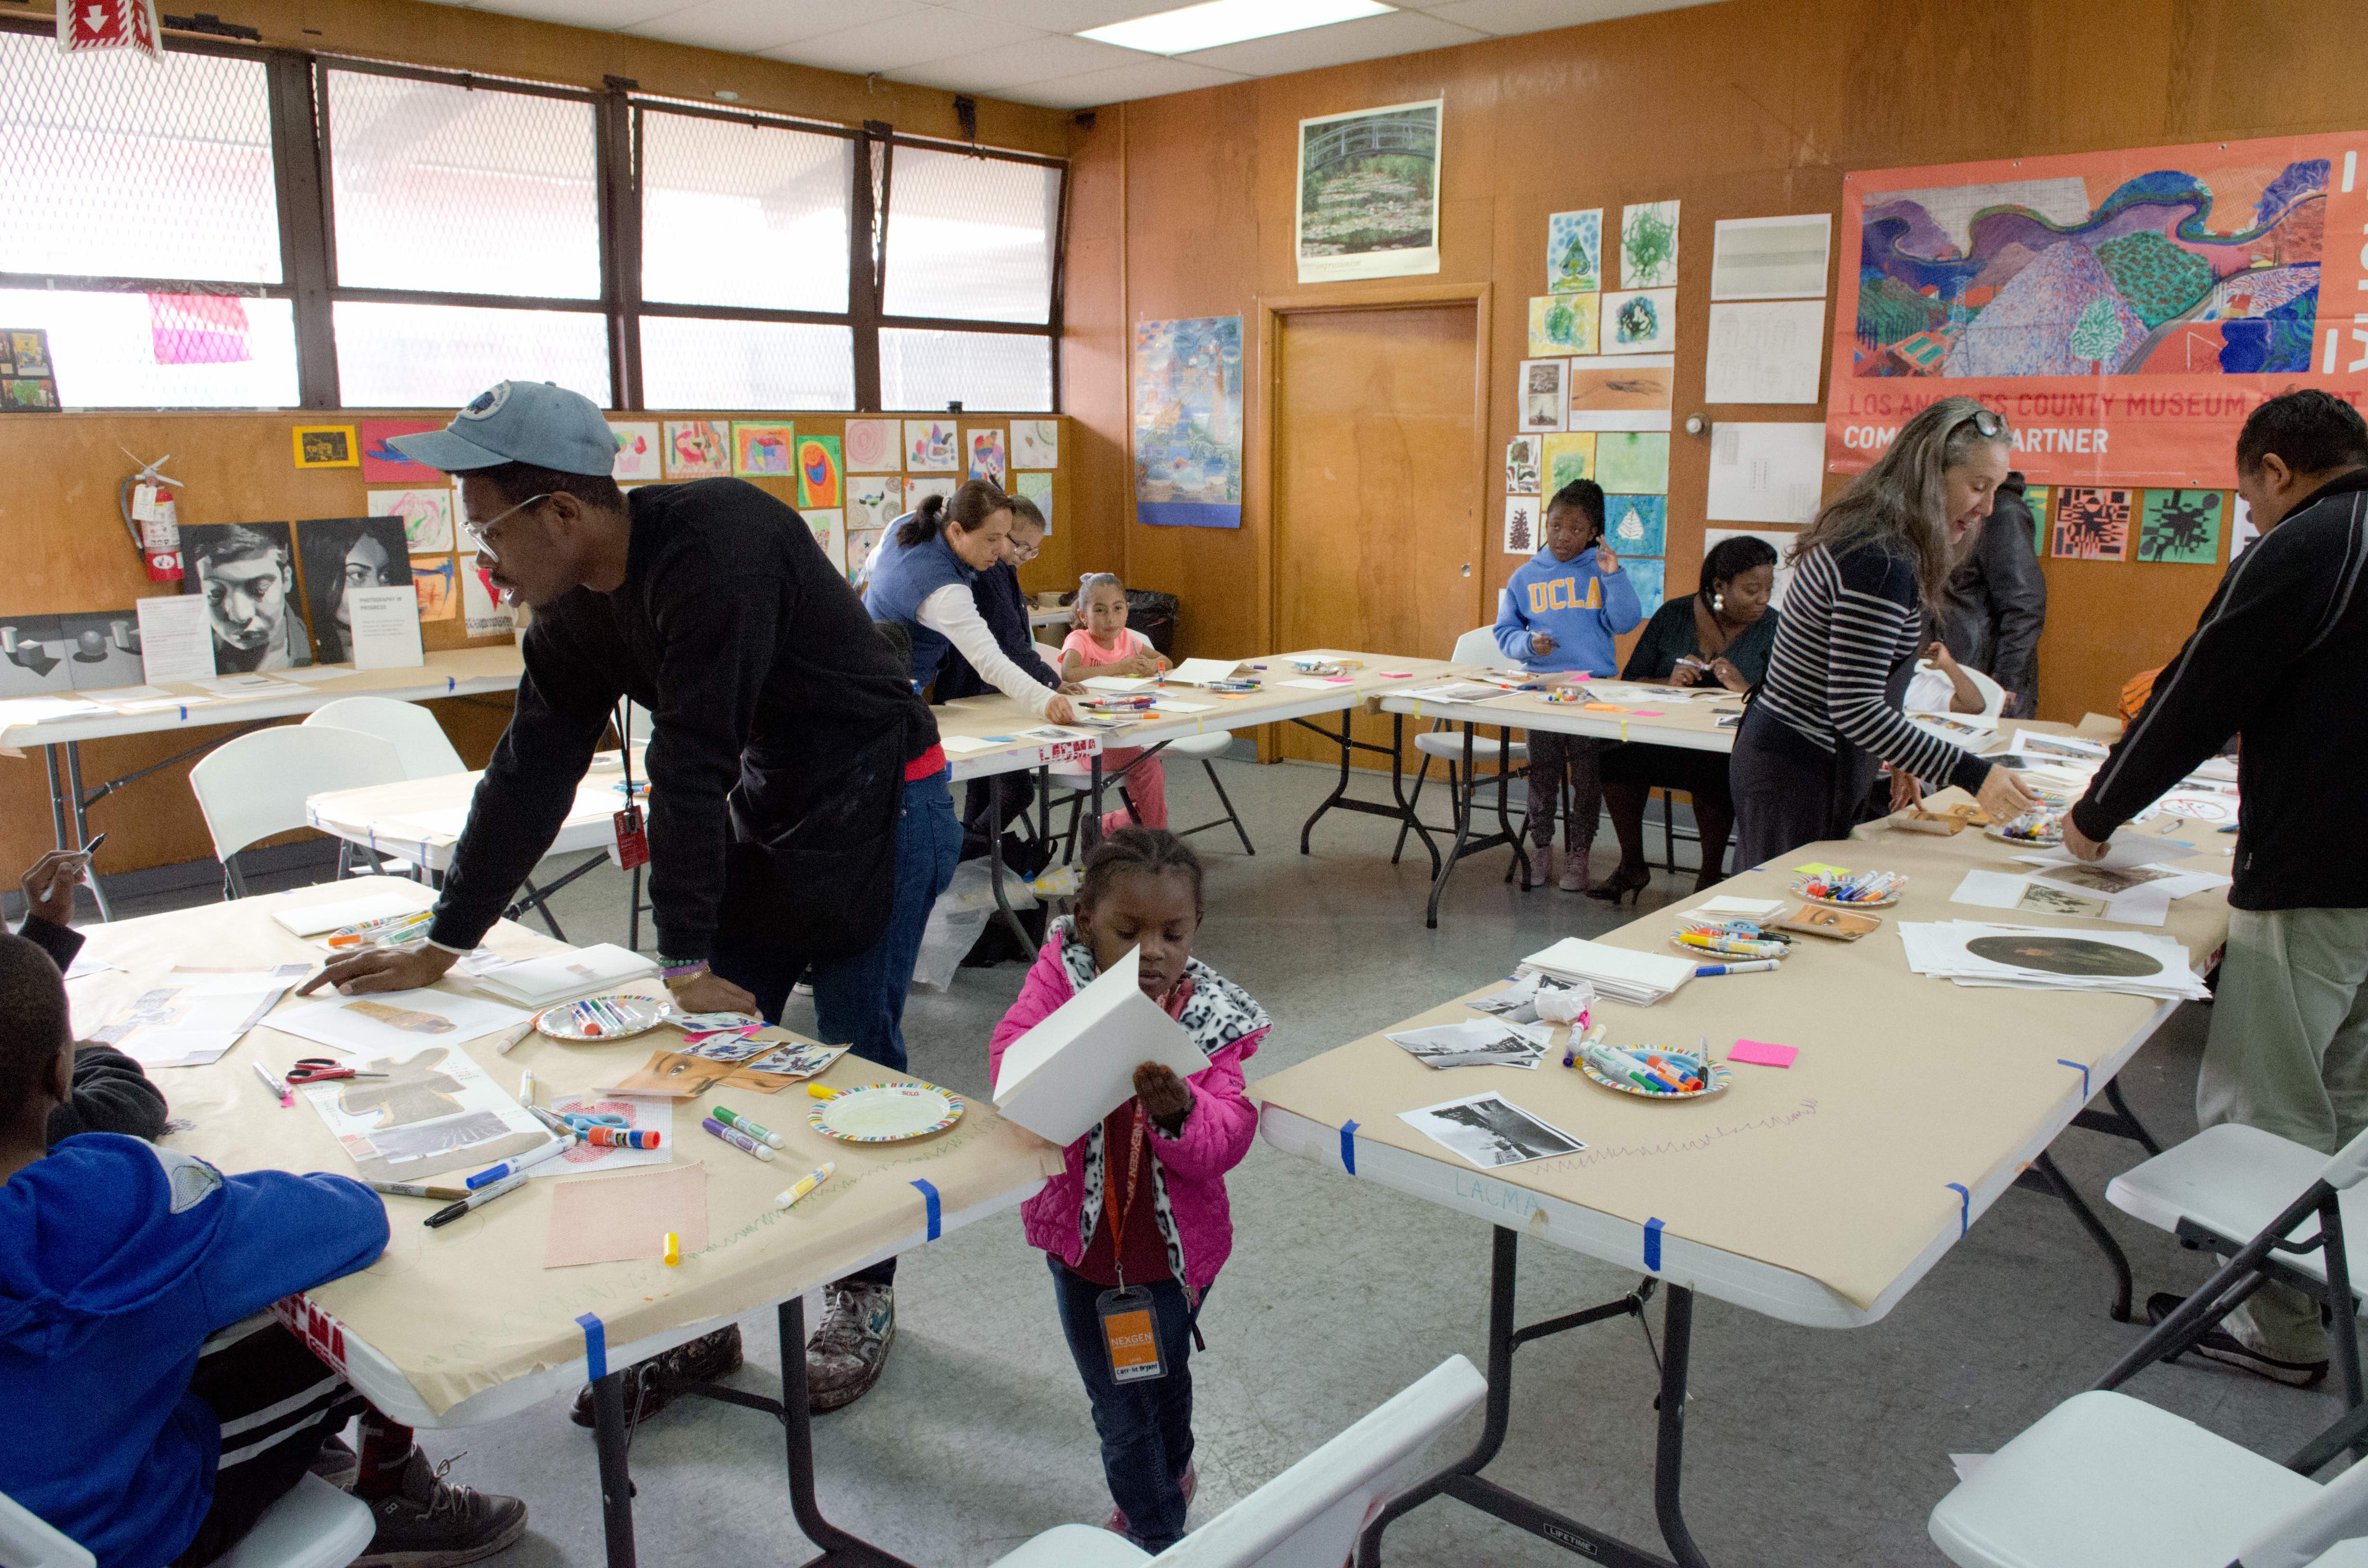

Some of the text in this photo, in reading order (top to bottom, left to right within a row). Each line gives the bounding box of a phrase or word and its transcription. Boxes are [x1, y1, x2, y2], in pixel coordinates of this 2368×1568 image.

[1849, 393, 1891, 416] LOS
[2019, 392, 2114, 416] COUNTY
[2126, 392, 2245, 416] MUSEUM
[2010, 428, 2109, 453] ARTNER
[1528, 576, 1603, 613] UCLA
[1456, 1172, 1541, 1216] LACMA
[1111, 1332, 1152, 1346] NEXGEN
[1550, 1527, 1591, 1551] LIFETIME
